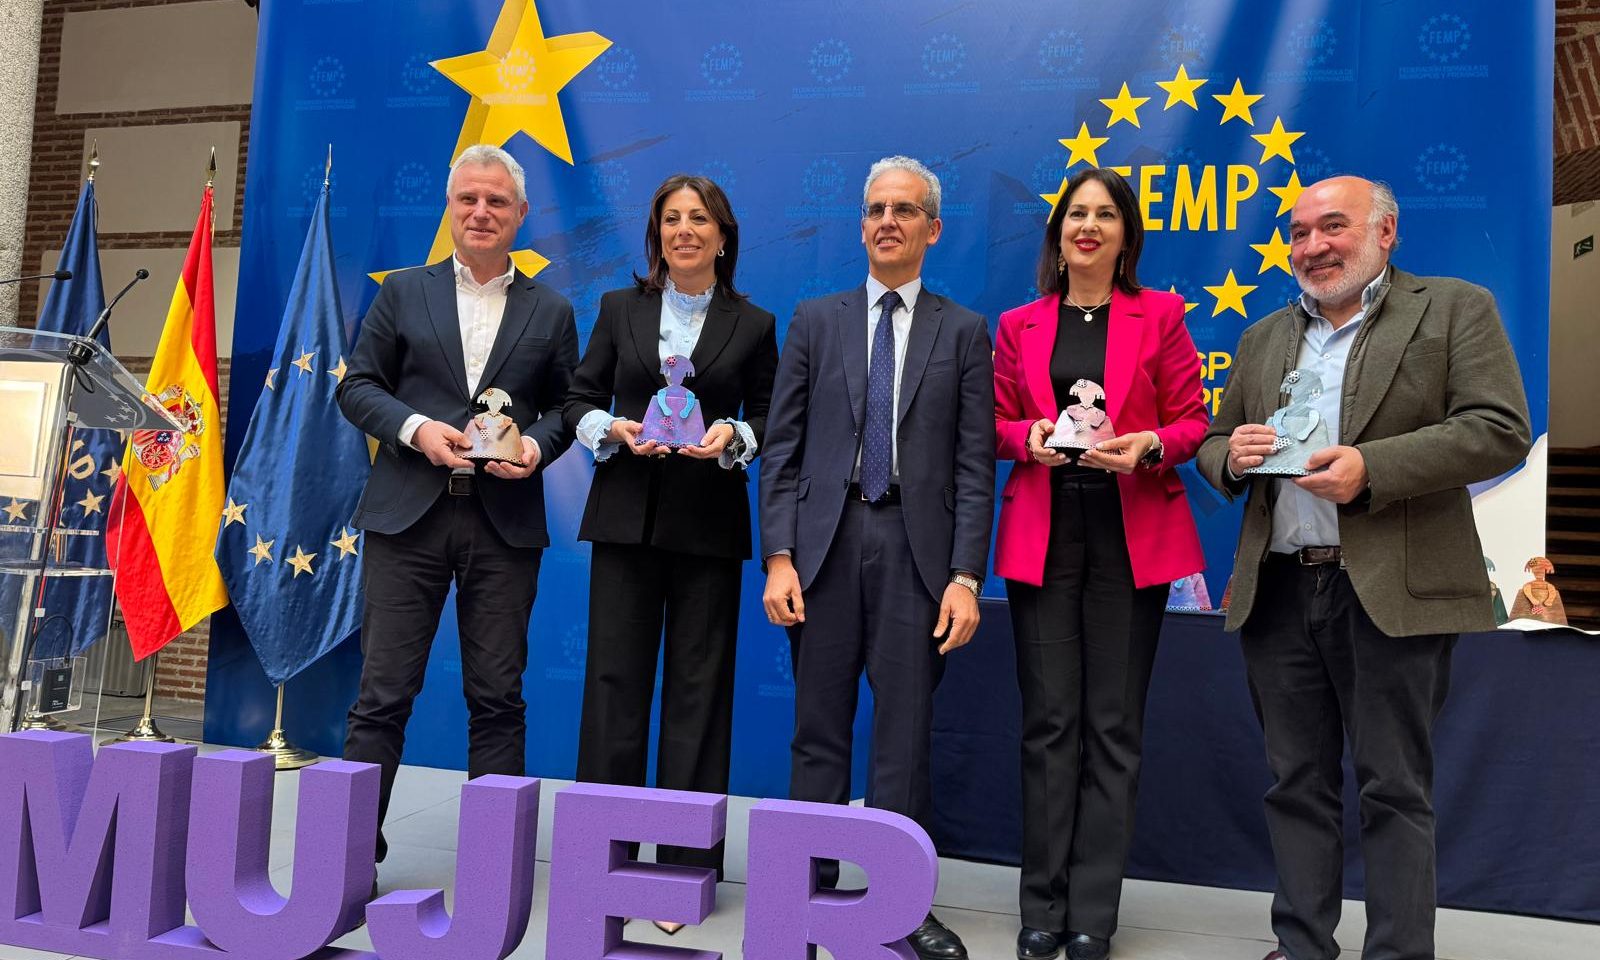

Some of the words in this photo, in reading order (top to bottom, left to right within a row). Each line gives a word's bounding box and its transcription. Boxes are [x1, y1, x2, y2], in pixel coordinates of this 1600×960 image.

[1296, 34, 1328, 49] FEMP
[1429, 30, 1461, 45] FEMP
[1046, 44, 1076, 58] FEMP
[1170, 39, 1200, 53] FEMP
[817, 53, 844, 68] FEMP
[930, 49, 958, 63] FEMP
[606, 61, 630, 75] FEMP
[708, 57, 736, 72] FEMP
[315, 70, 339, 82] FEMP
[1426, 160, 1459, 175] FEMP
[400, 175, 425, 189] FEMP
[599, 174, 624, 188] FEMP
[811, 174, 838, 188] FEMP
[1106, 164, 1259, 231] EMP
[0, 729, 938, 960] MUJER
